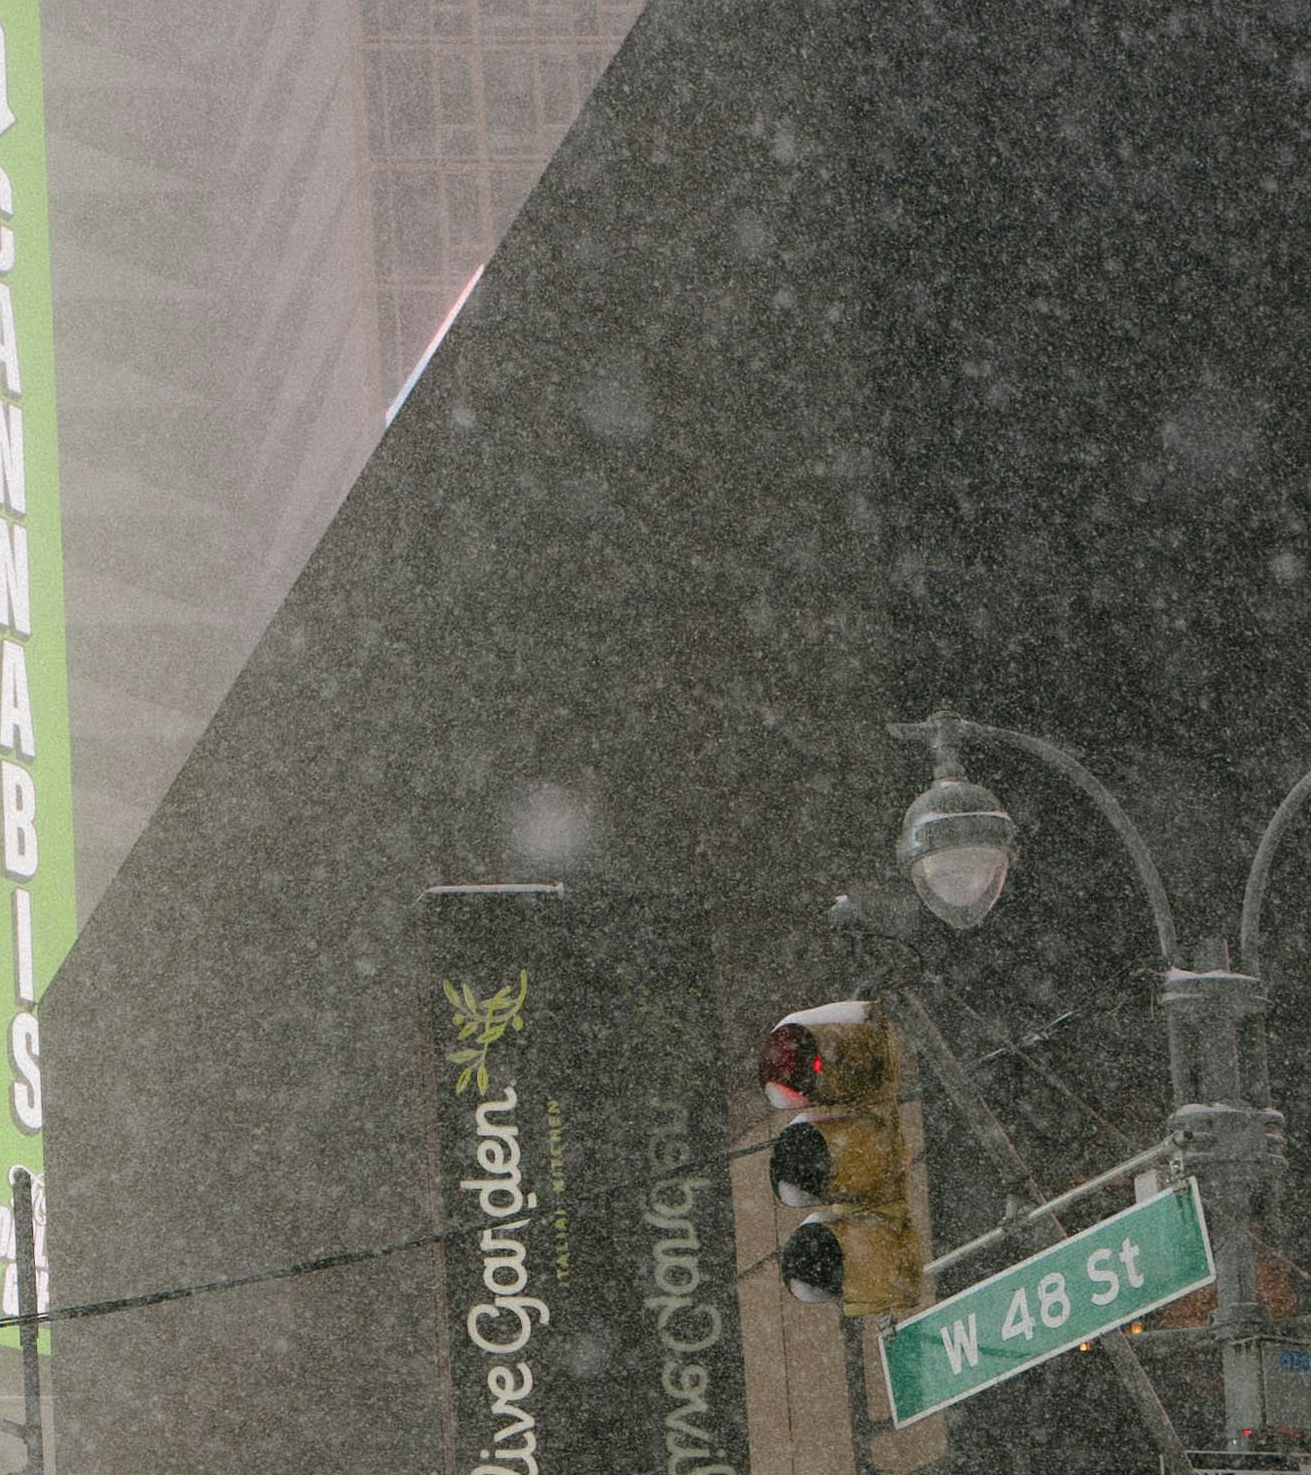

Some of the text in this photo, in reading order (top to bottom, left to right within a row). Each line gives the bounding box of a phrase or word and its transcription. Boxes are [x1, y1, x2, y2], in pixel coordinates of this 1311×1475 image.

[546, 1100, 566, 1194] KITCHEN
[459, 1083, 550, 1354] Garden
[940, 1236, 1146, 1375] W 48 St
